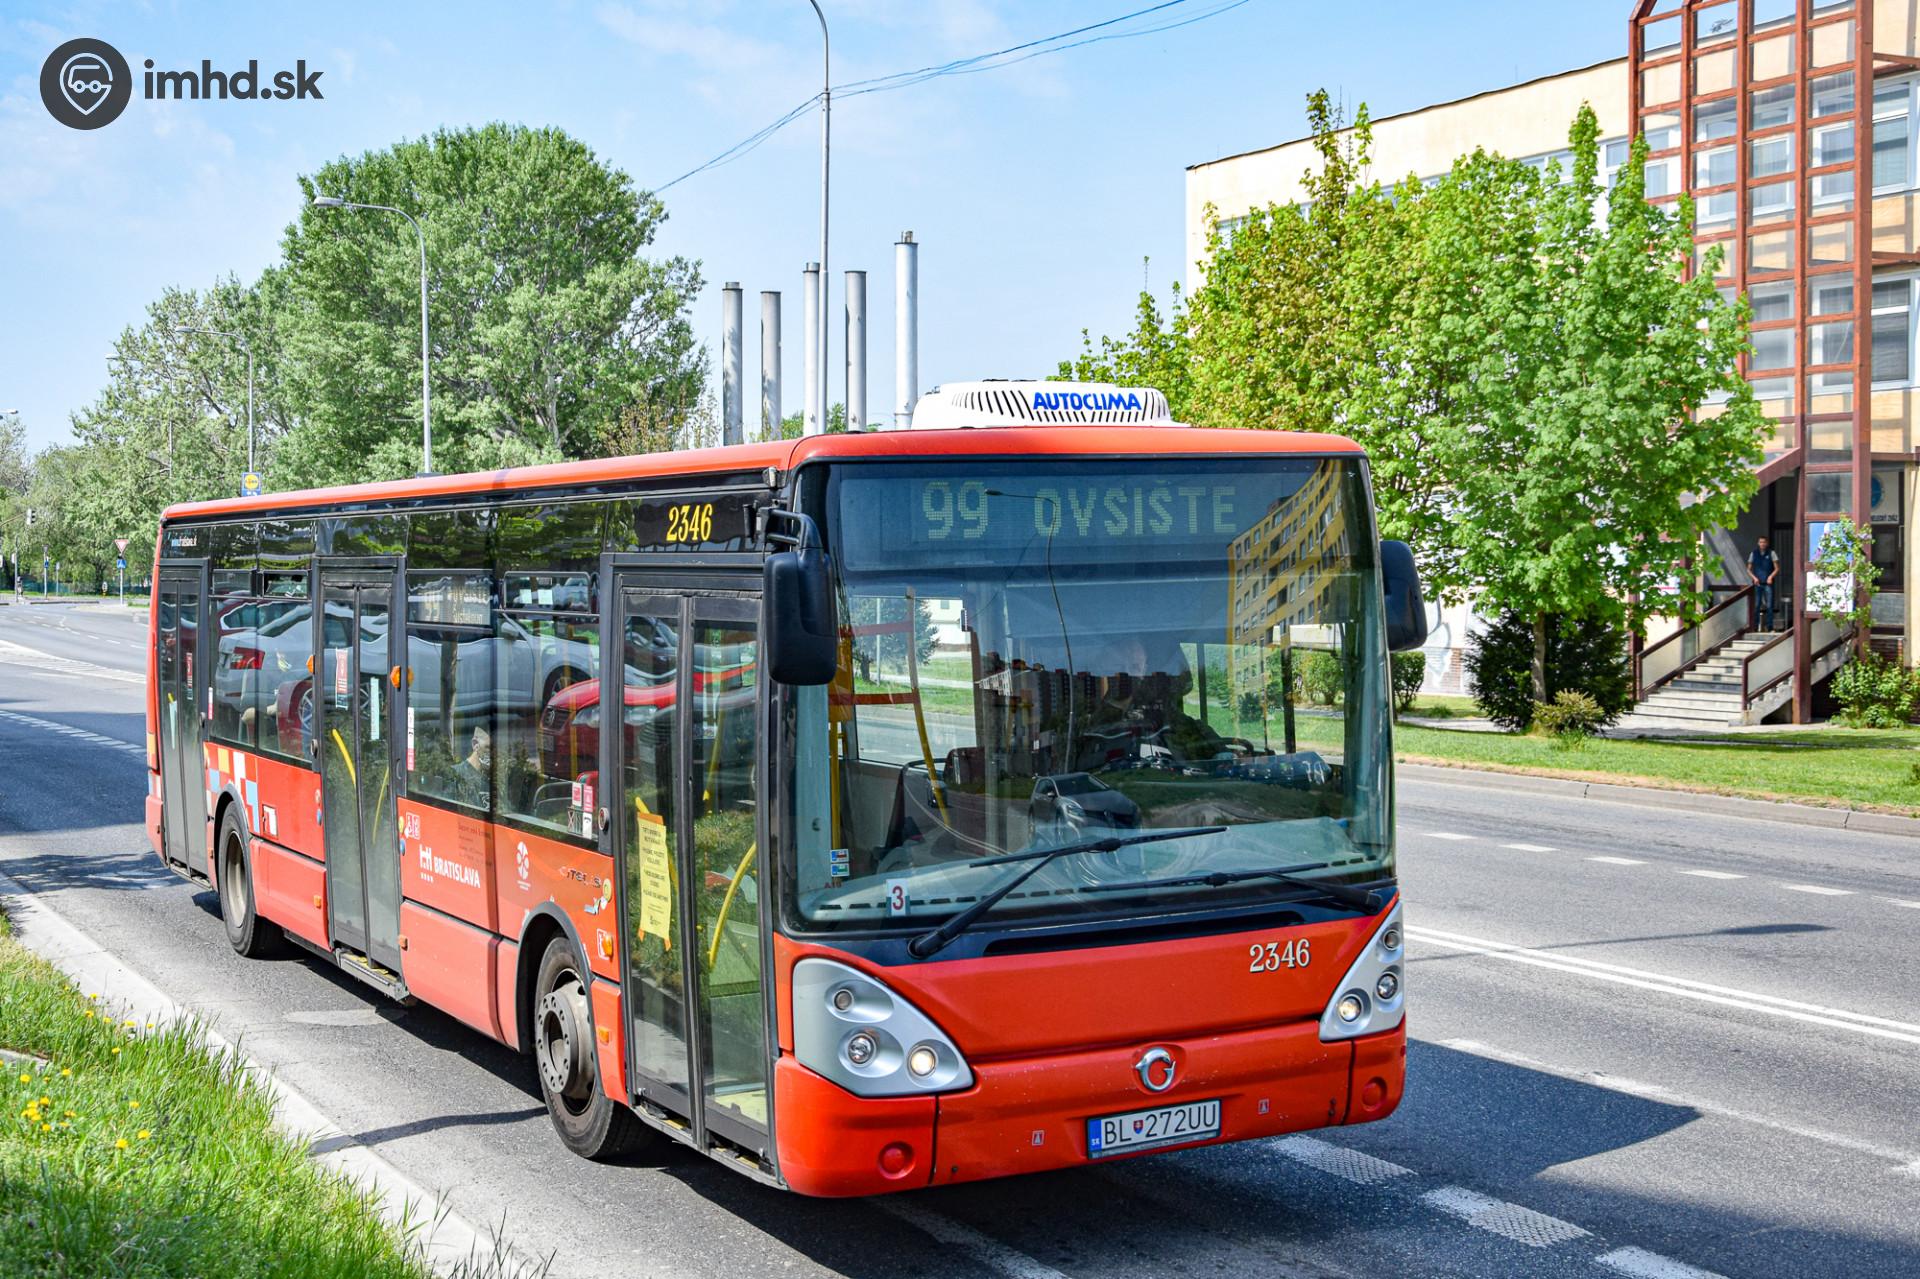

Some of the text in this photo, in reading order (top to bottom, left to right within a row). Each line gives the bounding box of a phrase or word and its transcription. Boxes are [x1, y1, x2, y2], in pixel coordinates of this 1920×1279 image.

[1033, 392, 1142, 411] AUTOCLIMA
[666, 504, 713, 542] 2346
[922, 480, 1237, 539] 99 OVSIŠTE
[433, 855, 481, 890] BRATISLAVA
[892, 885, 905, 911] 3
[1249, 938, 1311, 973] 2346
[1104, 1119, 1132, 1145] BL
[1145, 1103, 1217, 1138] 272UU
